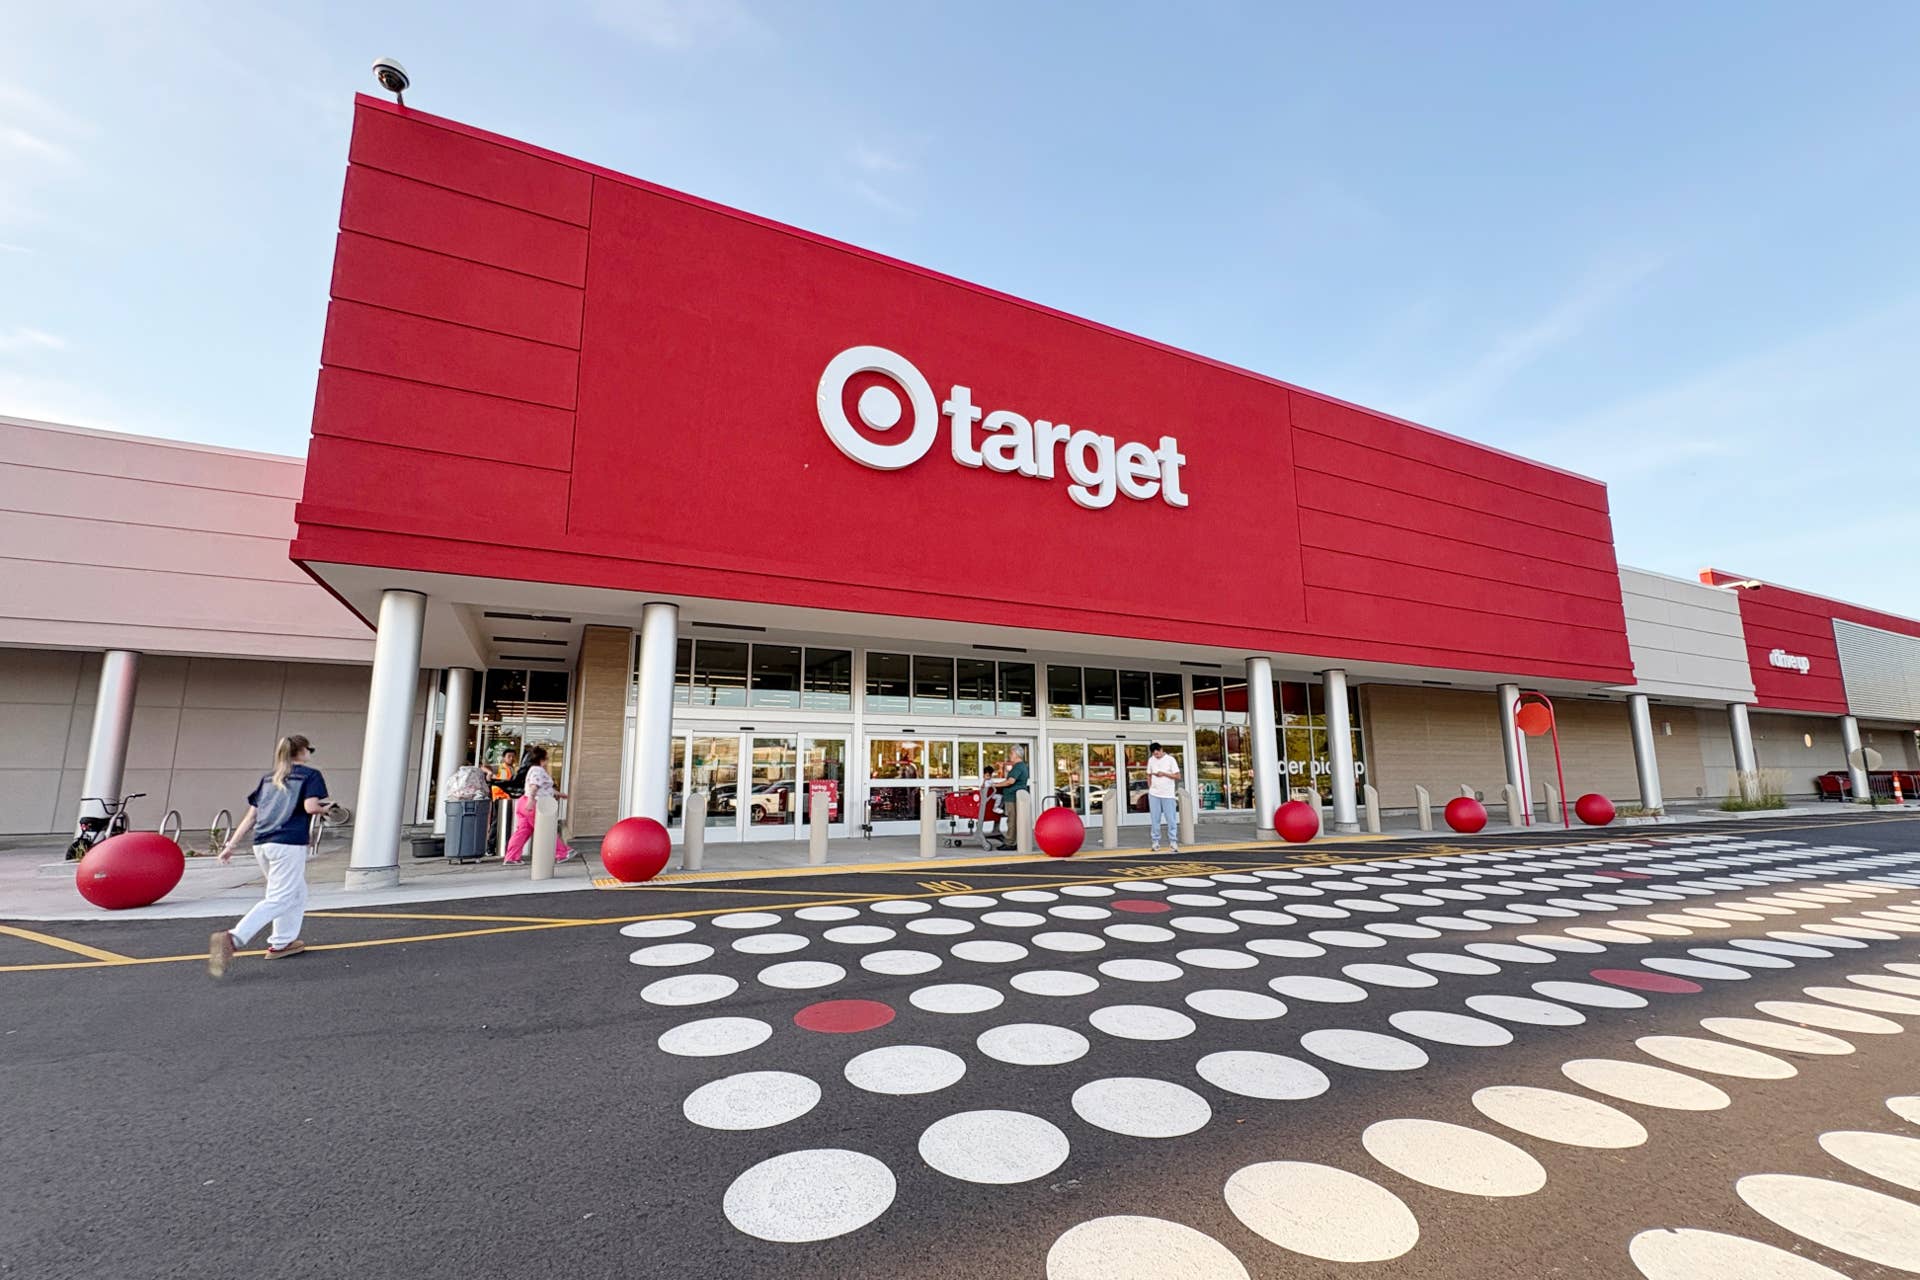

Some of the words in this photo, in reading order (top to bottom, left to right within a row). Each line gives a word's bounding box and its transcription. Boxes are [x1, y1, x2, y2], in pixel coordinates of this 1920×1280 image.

[942, 385, 1189, 509] target
[1310, 757, 1365, 779] picp
[916, 880, 973, 892] NO
